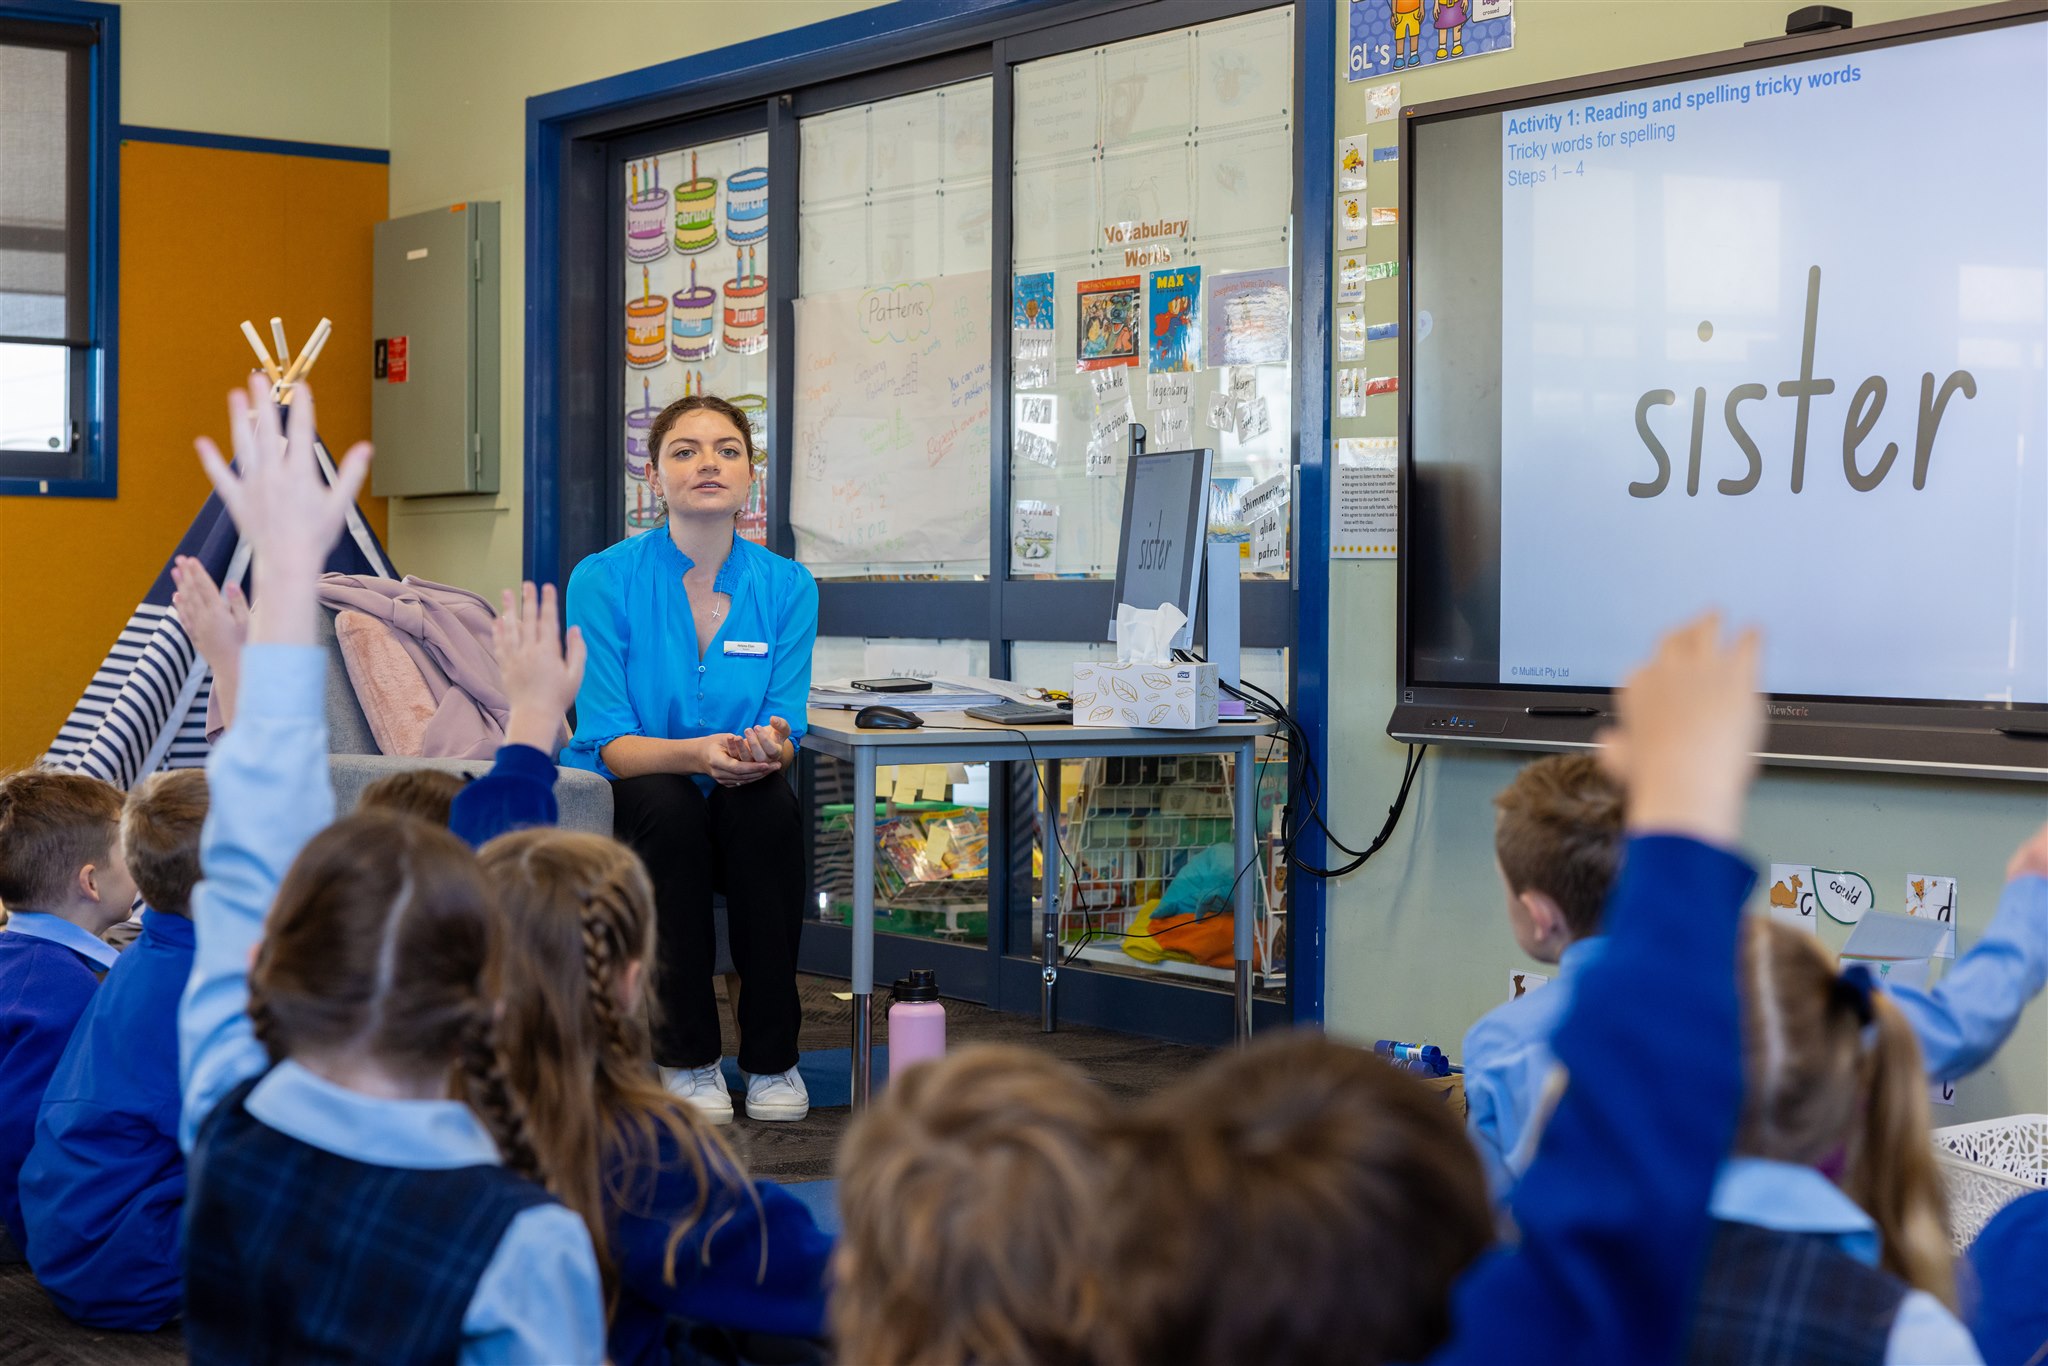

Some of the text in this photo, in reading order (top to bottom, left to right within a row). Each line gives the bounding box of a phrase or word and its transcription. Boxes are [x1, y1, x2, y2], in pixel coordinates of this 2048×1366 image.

[1507, 64, 1862, 136] Activity 1: Reading and spelling tricky words
[1508, 123, 1676, 160] Tricky words for spelling
[1508, 169, 1546, 188] Steps
[1551, 164, 1558, 180] 1
[1575, 160, 1584, 177] 4
[1104, 219, 1188, 243] Vocabulary
[1157, 274, 1184, 289] MAX
[732, 308, 758, 324] June
[868, 292, 924, 323] Patterns
[1152, 380, 1189, 404] legendary
[1628, 264, 1977, 498] sister
[1243, 484, 1285, 514] shimmering
[1138, 509, 1172, 570] sister
[1259, 516, 1276, 541] glide
[1258, 545, 1281, 567] patrol
[1519, 666, 1544, 677] MultiLit
[1558, 667, 1570, 677] Ltd
[1799, 893, 1813, 916] c
[1829, 879, 1863, 906] could
[1937, 882, 1954, 923] d
